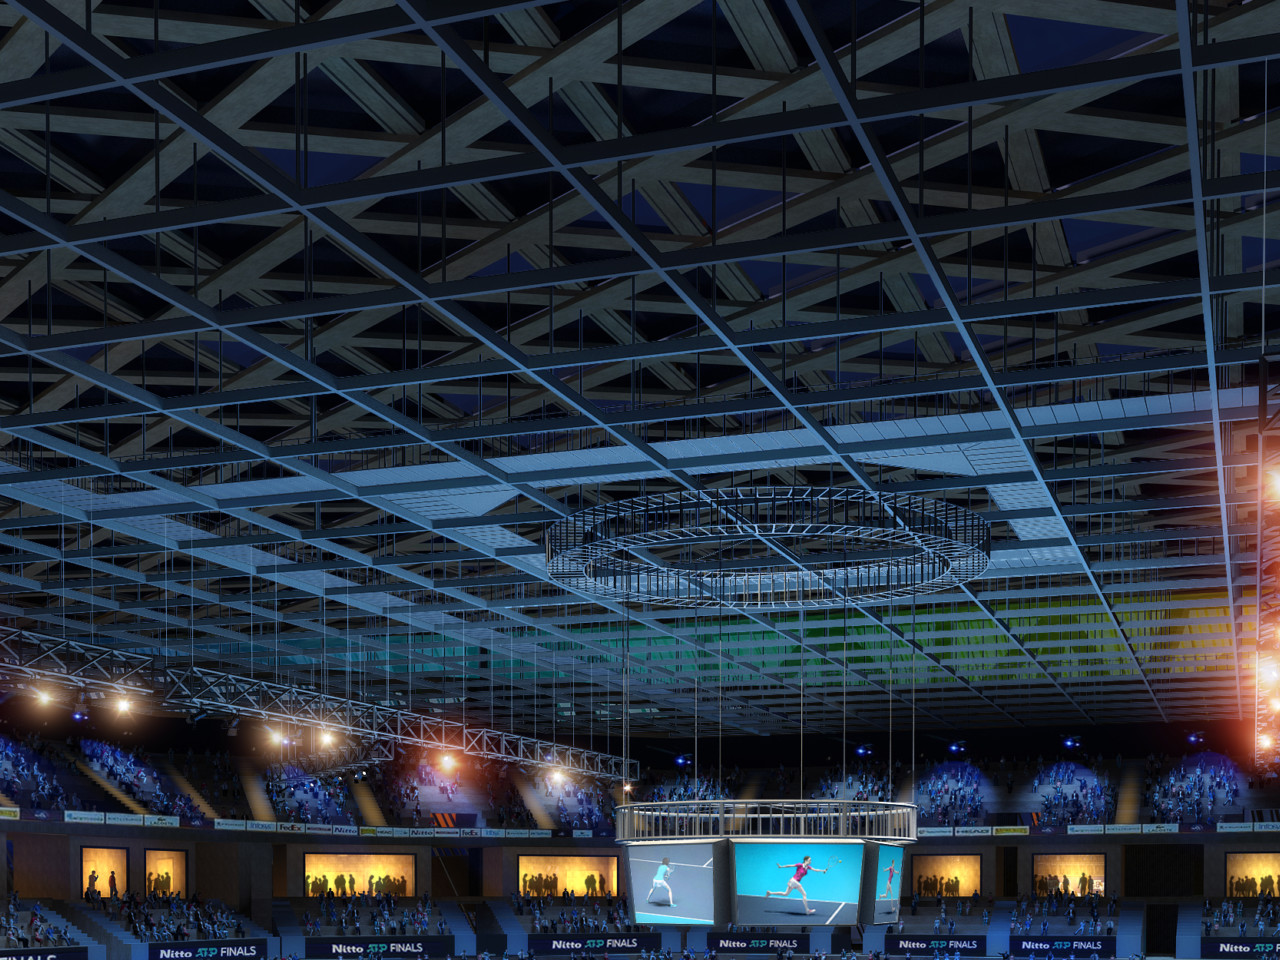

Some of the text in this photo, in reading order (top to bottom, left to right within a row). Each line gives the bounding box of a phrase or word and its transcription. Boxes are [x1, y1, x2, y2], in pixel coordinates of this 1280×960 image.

[552, 938, 637, 949] Nitto ATP FINALS
[720, 939, 798, 948] Nitto ATP FINALS
[899, 940, 977, 949] Nitto ATP FINALS
[1022, 941, 1102, 950] Nitto ATP FINALS
[1219, 943, 1250, 952] Nitto
[1253, 943, 1274, 952] ATP
[160, 946, 256, 959] Nitto ATP FINALS
[332, 943, 423, 954] Nitto ATP FINALS
